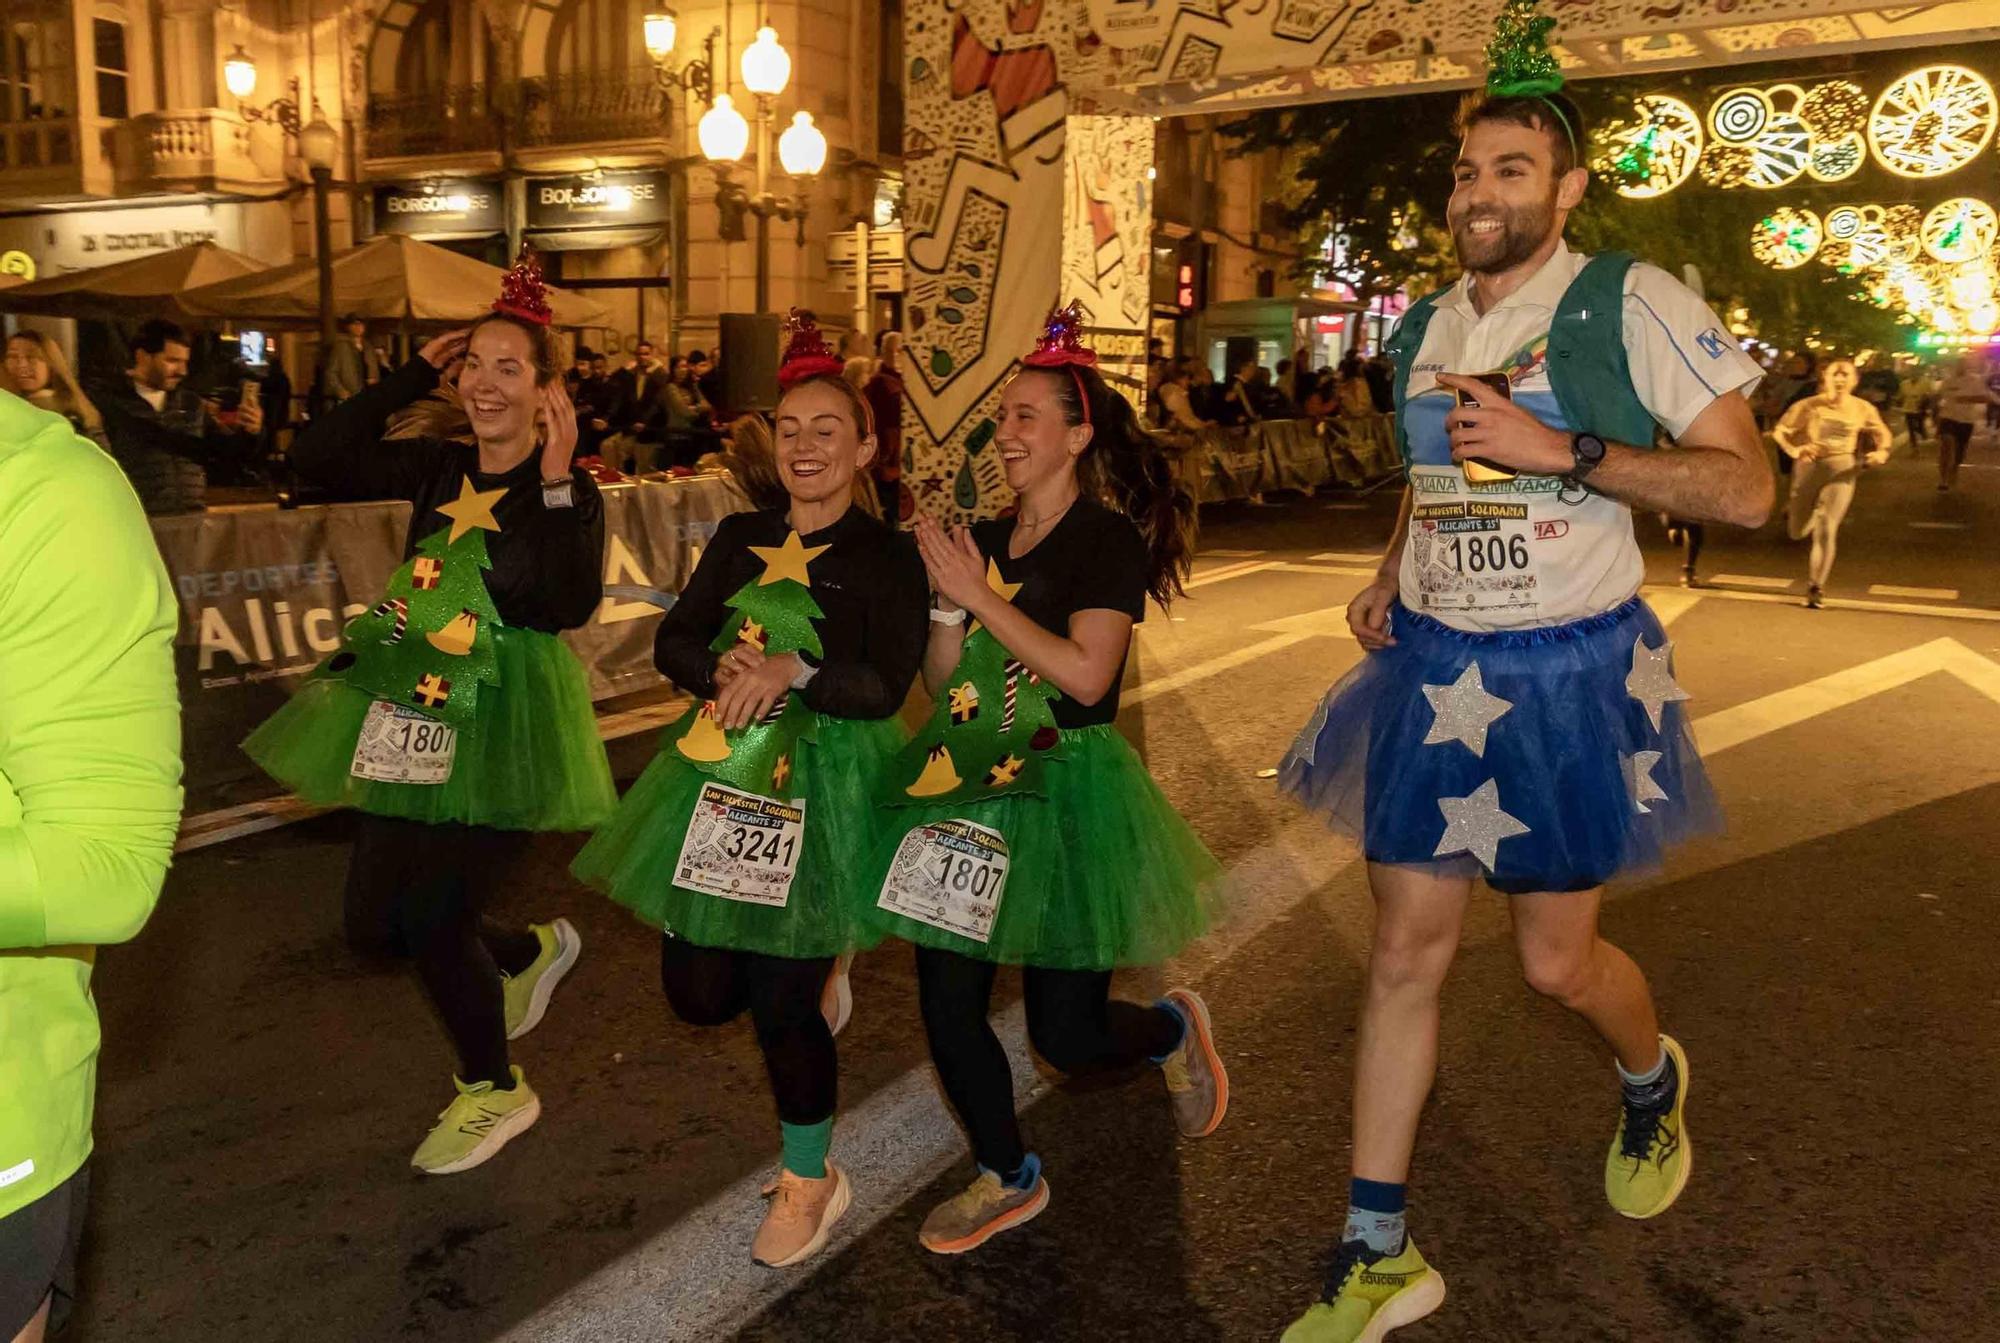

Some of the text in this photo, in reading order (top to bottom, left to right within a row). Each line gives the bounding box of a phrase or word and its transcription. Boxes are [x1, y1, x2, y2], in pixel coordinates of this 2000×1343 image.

[1470, 504, 1525, 517] SOLIDARIA
[1438, 521, 1483, 532] ALICANTE
[1450, 533, 1529, 573] 1806
[705, 789, 721, 800] SAN
[728, 811, 770, 827] ALICANTE
[727, 827, 796, 867] 3241
[937, 835, 979, 855] ALICANTE
[940, 853, 1003, 900] 1807
[1359, 1273, 1406, 1287] saucony
